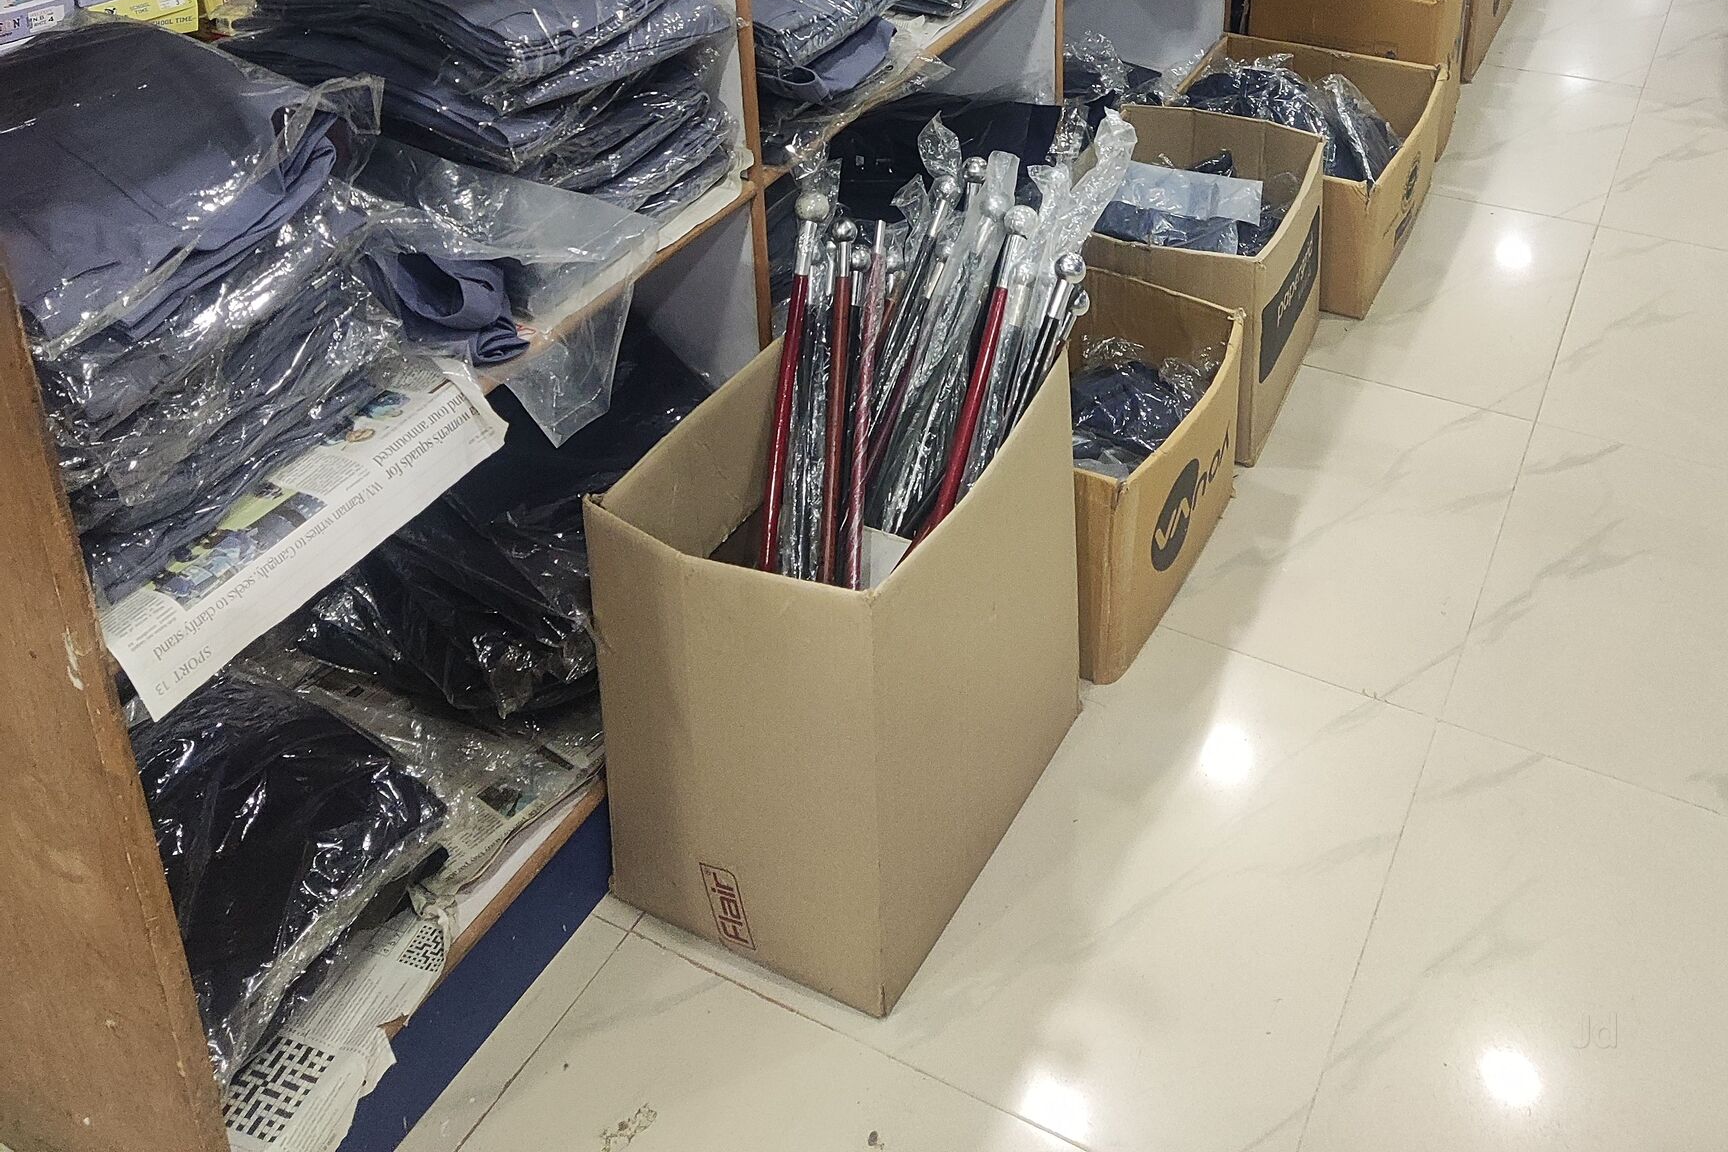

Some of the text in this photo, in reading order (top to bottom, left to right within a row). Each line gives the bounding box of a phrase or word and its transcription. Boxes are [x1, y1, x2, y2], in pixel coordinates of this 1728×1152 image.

[175, 16, 193, 24] TIME
[427, 405, 449, 425] tour
[372, 420, 428, 466] announced
[385, 411, 472, 479] women's squads for
[332, 492, 365, 519] Raman
[294, 537, 306, 548] to
[305, 517, 333, 541] writes
[227, 575, 255, 600] seeks
[215, 597, 228, 609] to
[184, 606, 215, 635] clarify
[153, 630, 184, 660] stand
[155, 646, 211, 695] SPORT 13
[711, 872, 749, 943] Flair
